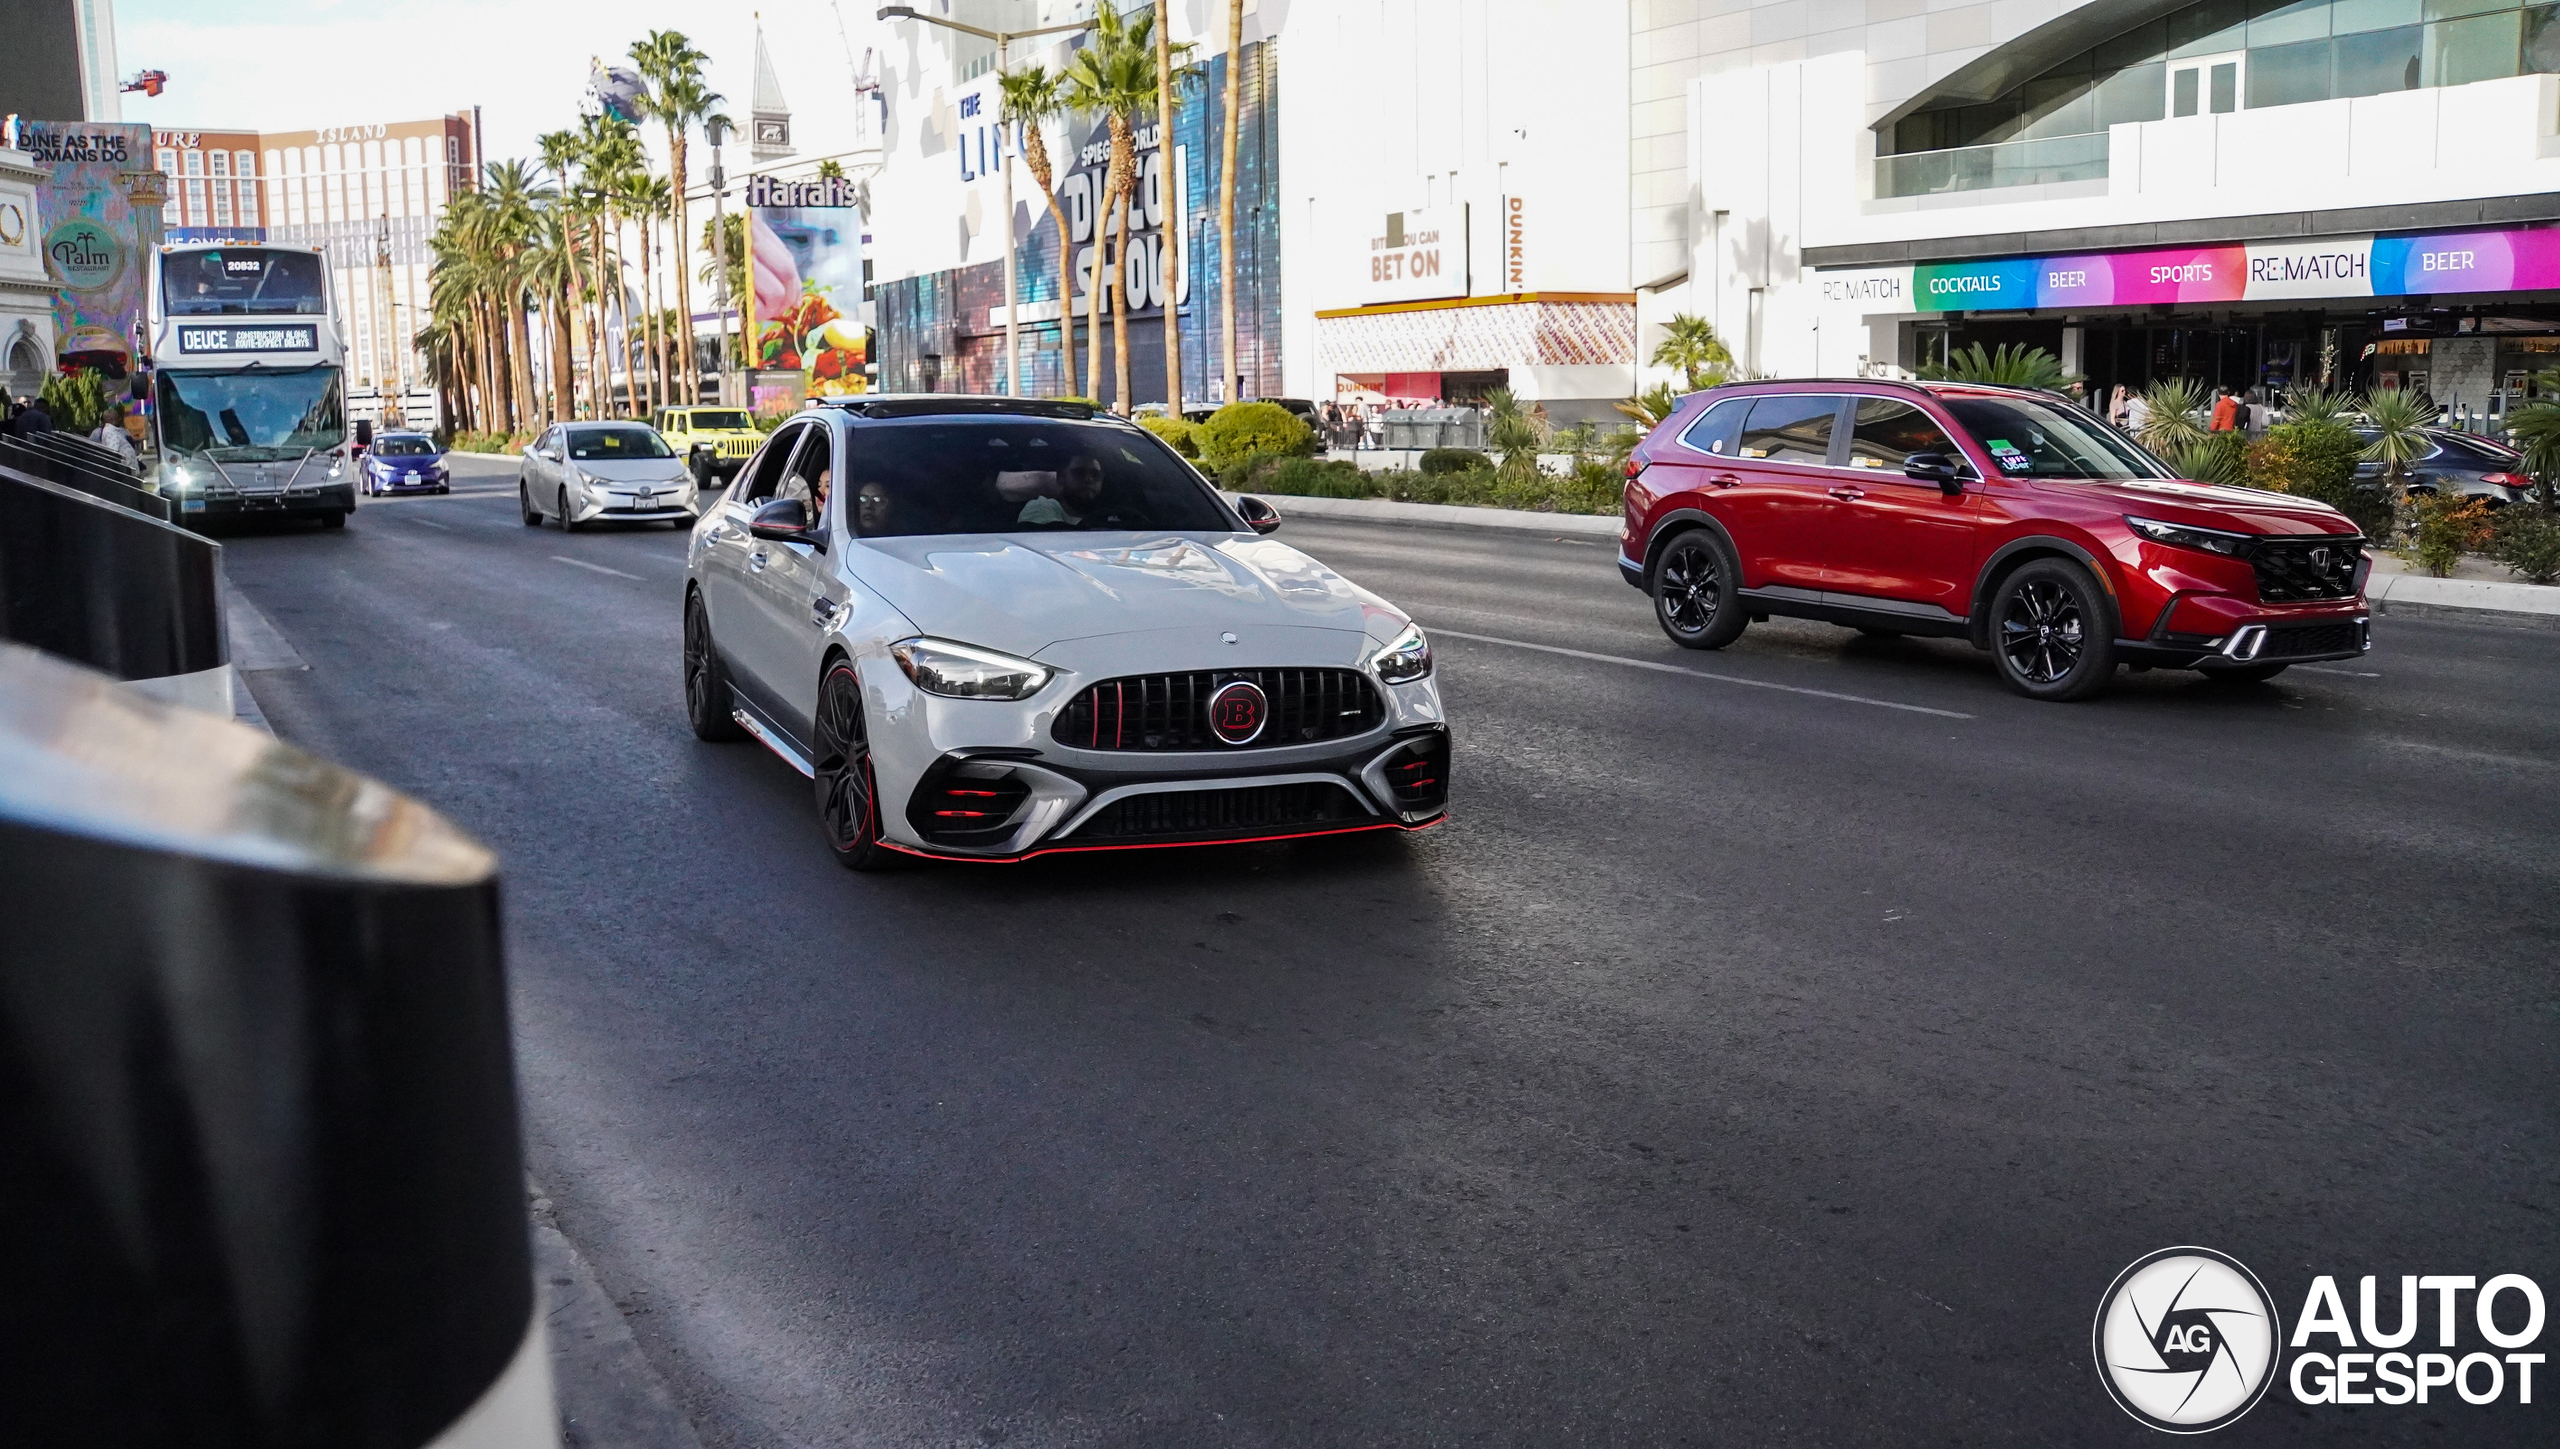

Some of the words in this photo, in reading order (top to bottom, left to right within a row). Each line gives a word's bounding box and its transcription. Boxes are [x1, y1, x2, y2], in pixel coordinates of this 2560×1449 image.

[959, 92, 981, 119] THE
[19, 134, 62, 148] DINE
[65, 135, 88, 148] AS
[91, 135, 126, 149] THE
[316, 123, 387, 144] ISLAND
[101, 150, 128, 162] DO
[52, 232, 110, 265] Palm
[1371, 236, 1387, 251] BIT
[1403, 232, 1417, 247] OU
[1419, 229, 1440, 245] CAN
[1510, 198, 1523, 289] DUNKIN'
[1371, 252, 1405, 282] BET
[1410, 249, 1440, 279] ON
[2422, 251, 2475, 271] BEER
[2048, 271, 2087, 288] BEER
[2150, 264, 2213, 284] SPORTS
[1929, 275, 2001, 294] COCKTAILS
[183, 330, 229, 350] DEUCE
[236, 331, 285, 341] CONSTRUCTION
[285, 330, 308, 340] ALONG
[2002, 462, 2029, 470] Uber
